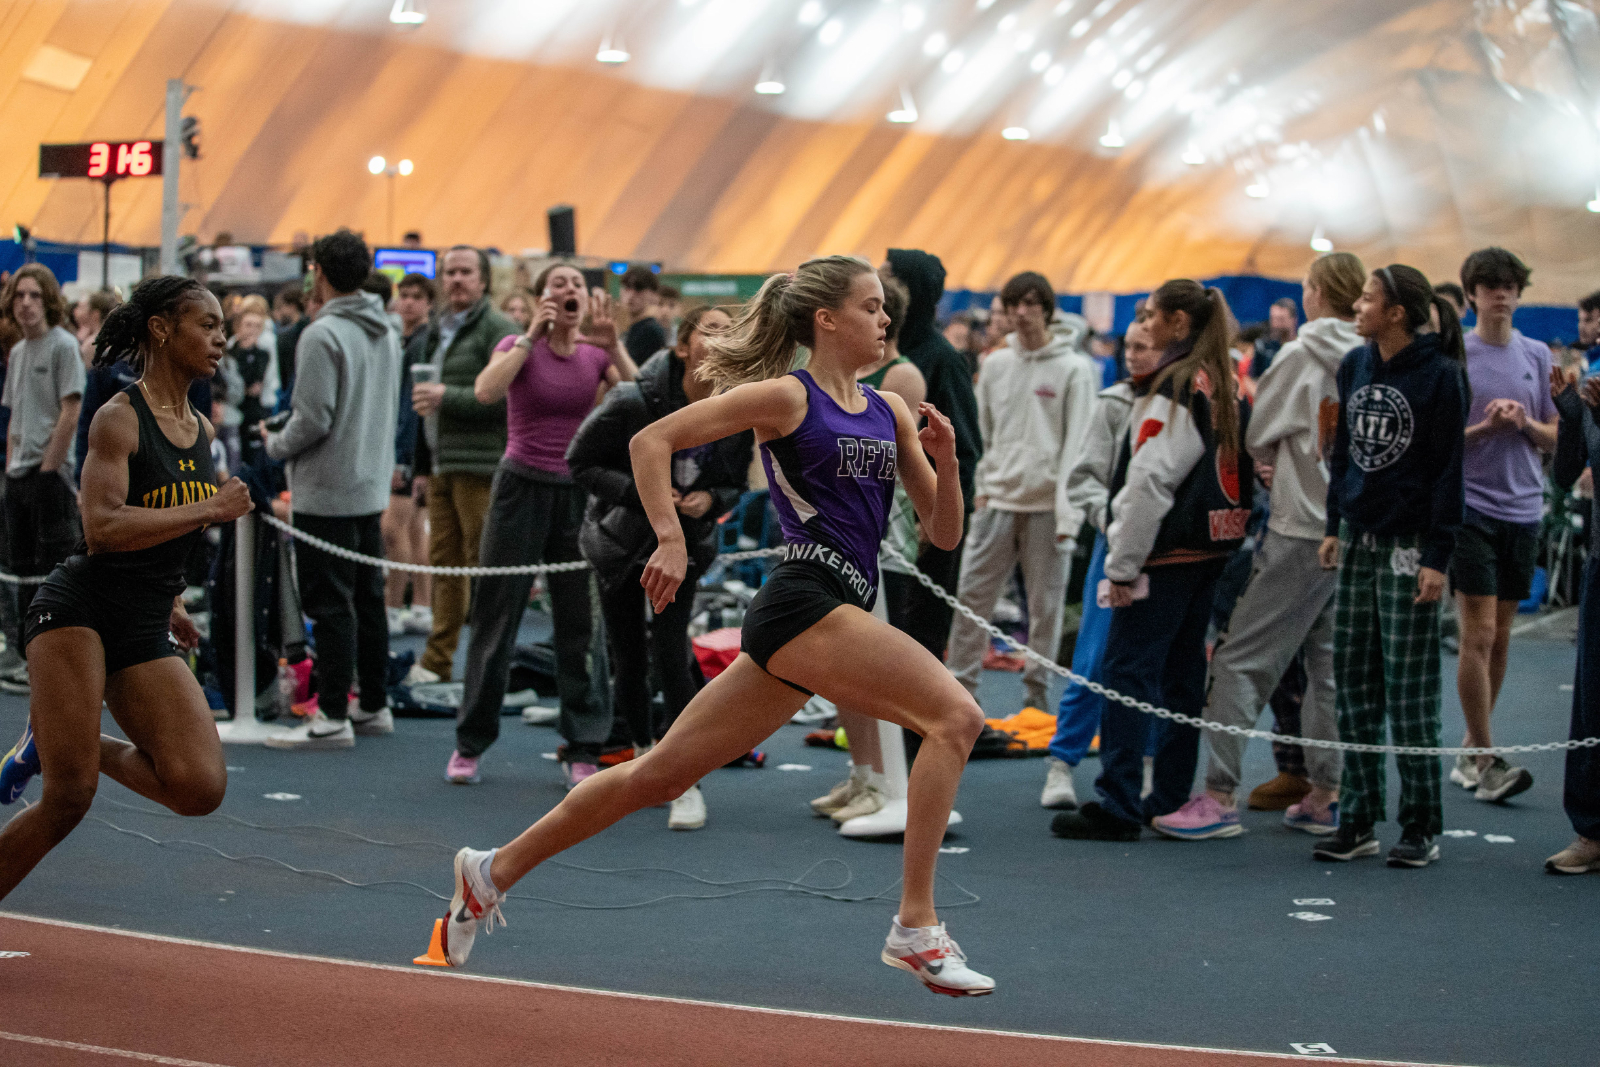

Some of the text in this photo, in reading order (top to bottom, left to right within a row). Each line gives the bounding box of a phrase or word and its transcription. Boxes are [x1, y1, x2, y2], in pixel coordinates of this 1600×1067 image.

[1352, 412, 1394, 441] ATL
[791, 543, 843, 569] NIKE
[841, 561, 868, 596] PRO
